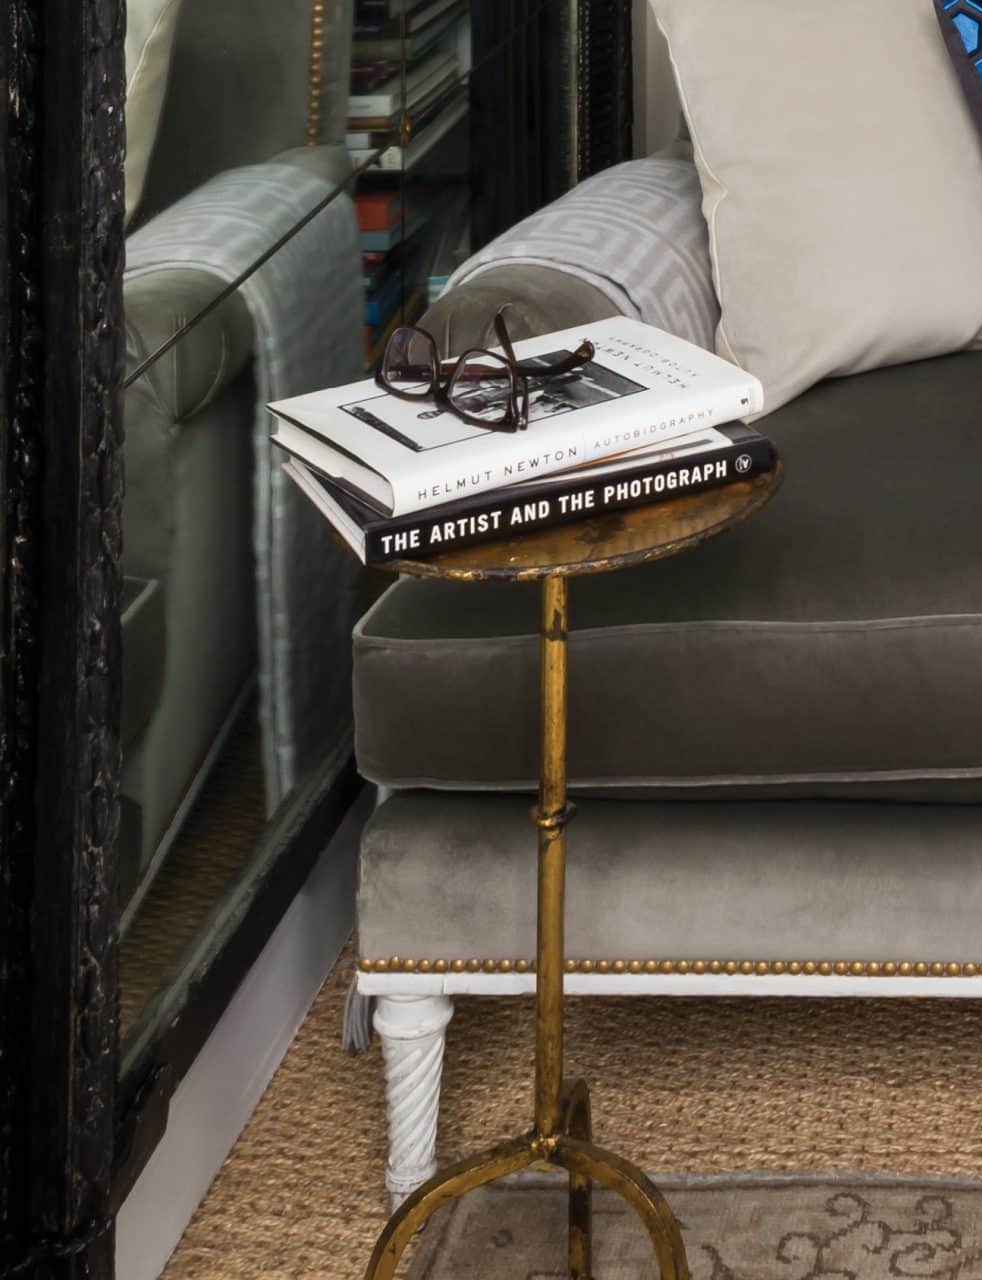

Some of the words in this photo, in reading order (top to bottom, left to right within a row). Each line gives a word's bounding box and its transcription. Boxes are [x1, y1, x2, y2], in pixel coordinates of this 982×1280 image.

[417, 471, 493, 500] HELMUT
[504, 446, 579, 476] NEWTON
[593, 407, 715, 449] AUTOBIOGRAPHY
[381, 530, 421, 554] THE
[429, 510, 503, 543] ARTIST
[510, 499, 550, 527] AND
[558, 490, 596, 516] THE
[603, 459, 728, 504] PHOTOGRAPH
